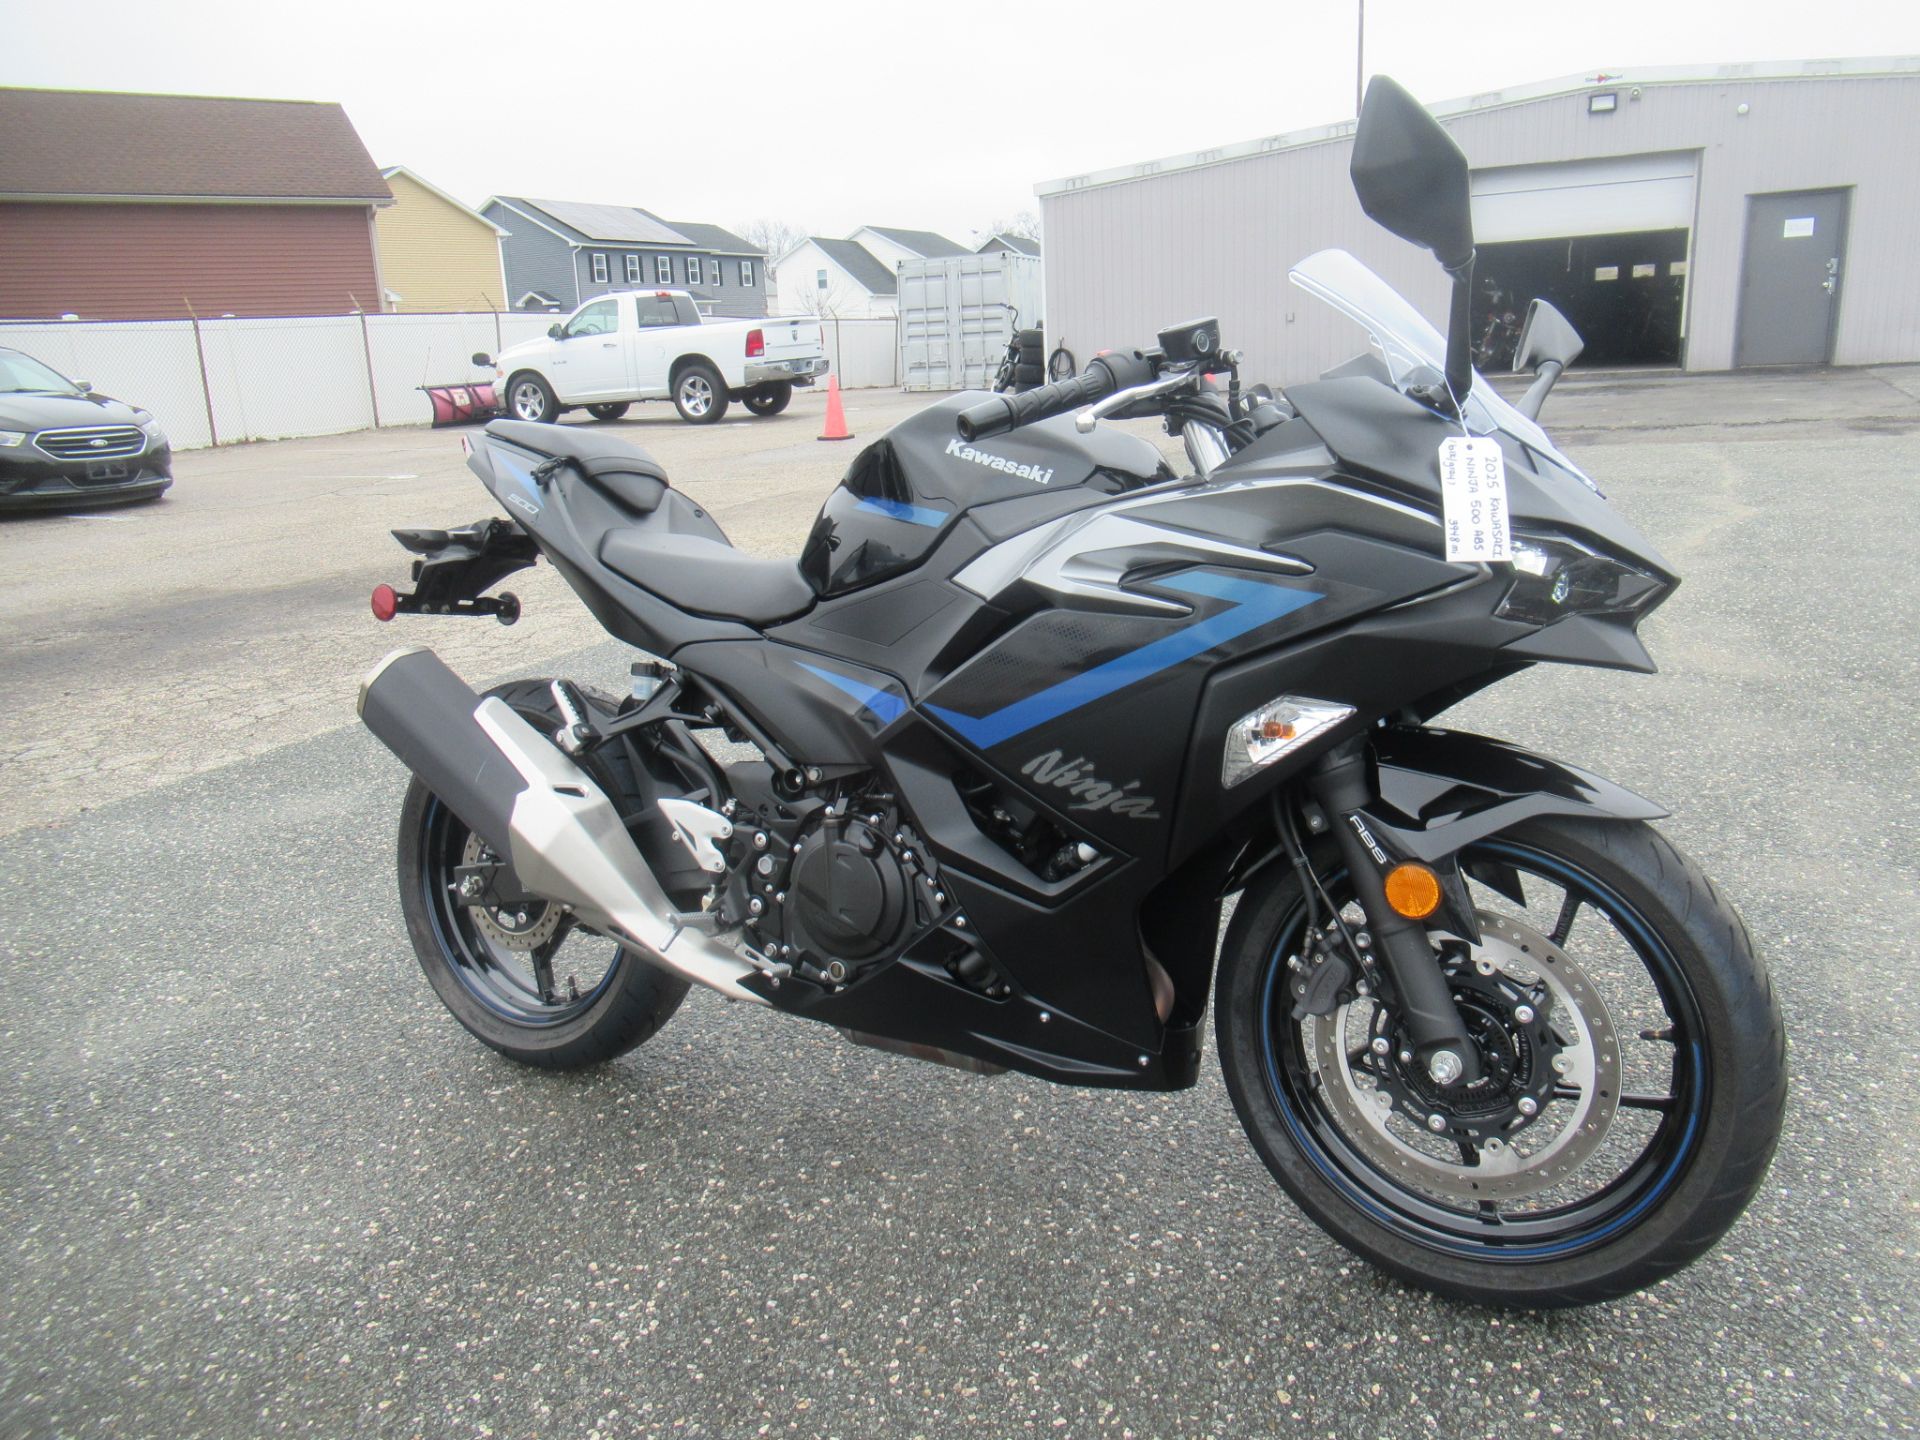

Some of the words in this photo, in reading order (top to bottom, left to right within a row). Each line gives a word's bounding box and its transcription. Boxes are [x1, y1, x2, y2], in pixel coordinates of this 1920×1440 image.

[944, 438, 1054, 485] Kawasaki
[1466, 457, 1478, 493] NINJA
[1485, 457, 1499, 489] 2025
[507, 493, 539, 514] 500
[1470, 500, 1482, 524] 500
[1474, 530, 1484, 551] ABS
[1490, 497, 1503, 558] KAWASAKI
[1021, 748, 1160, 819] Ninja
[1349, 815, 1387, 865] ABS
